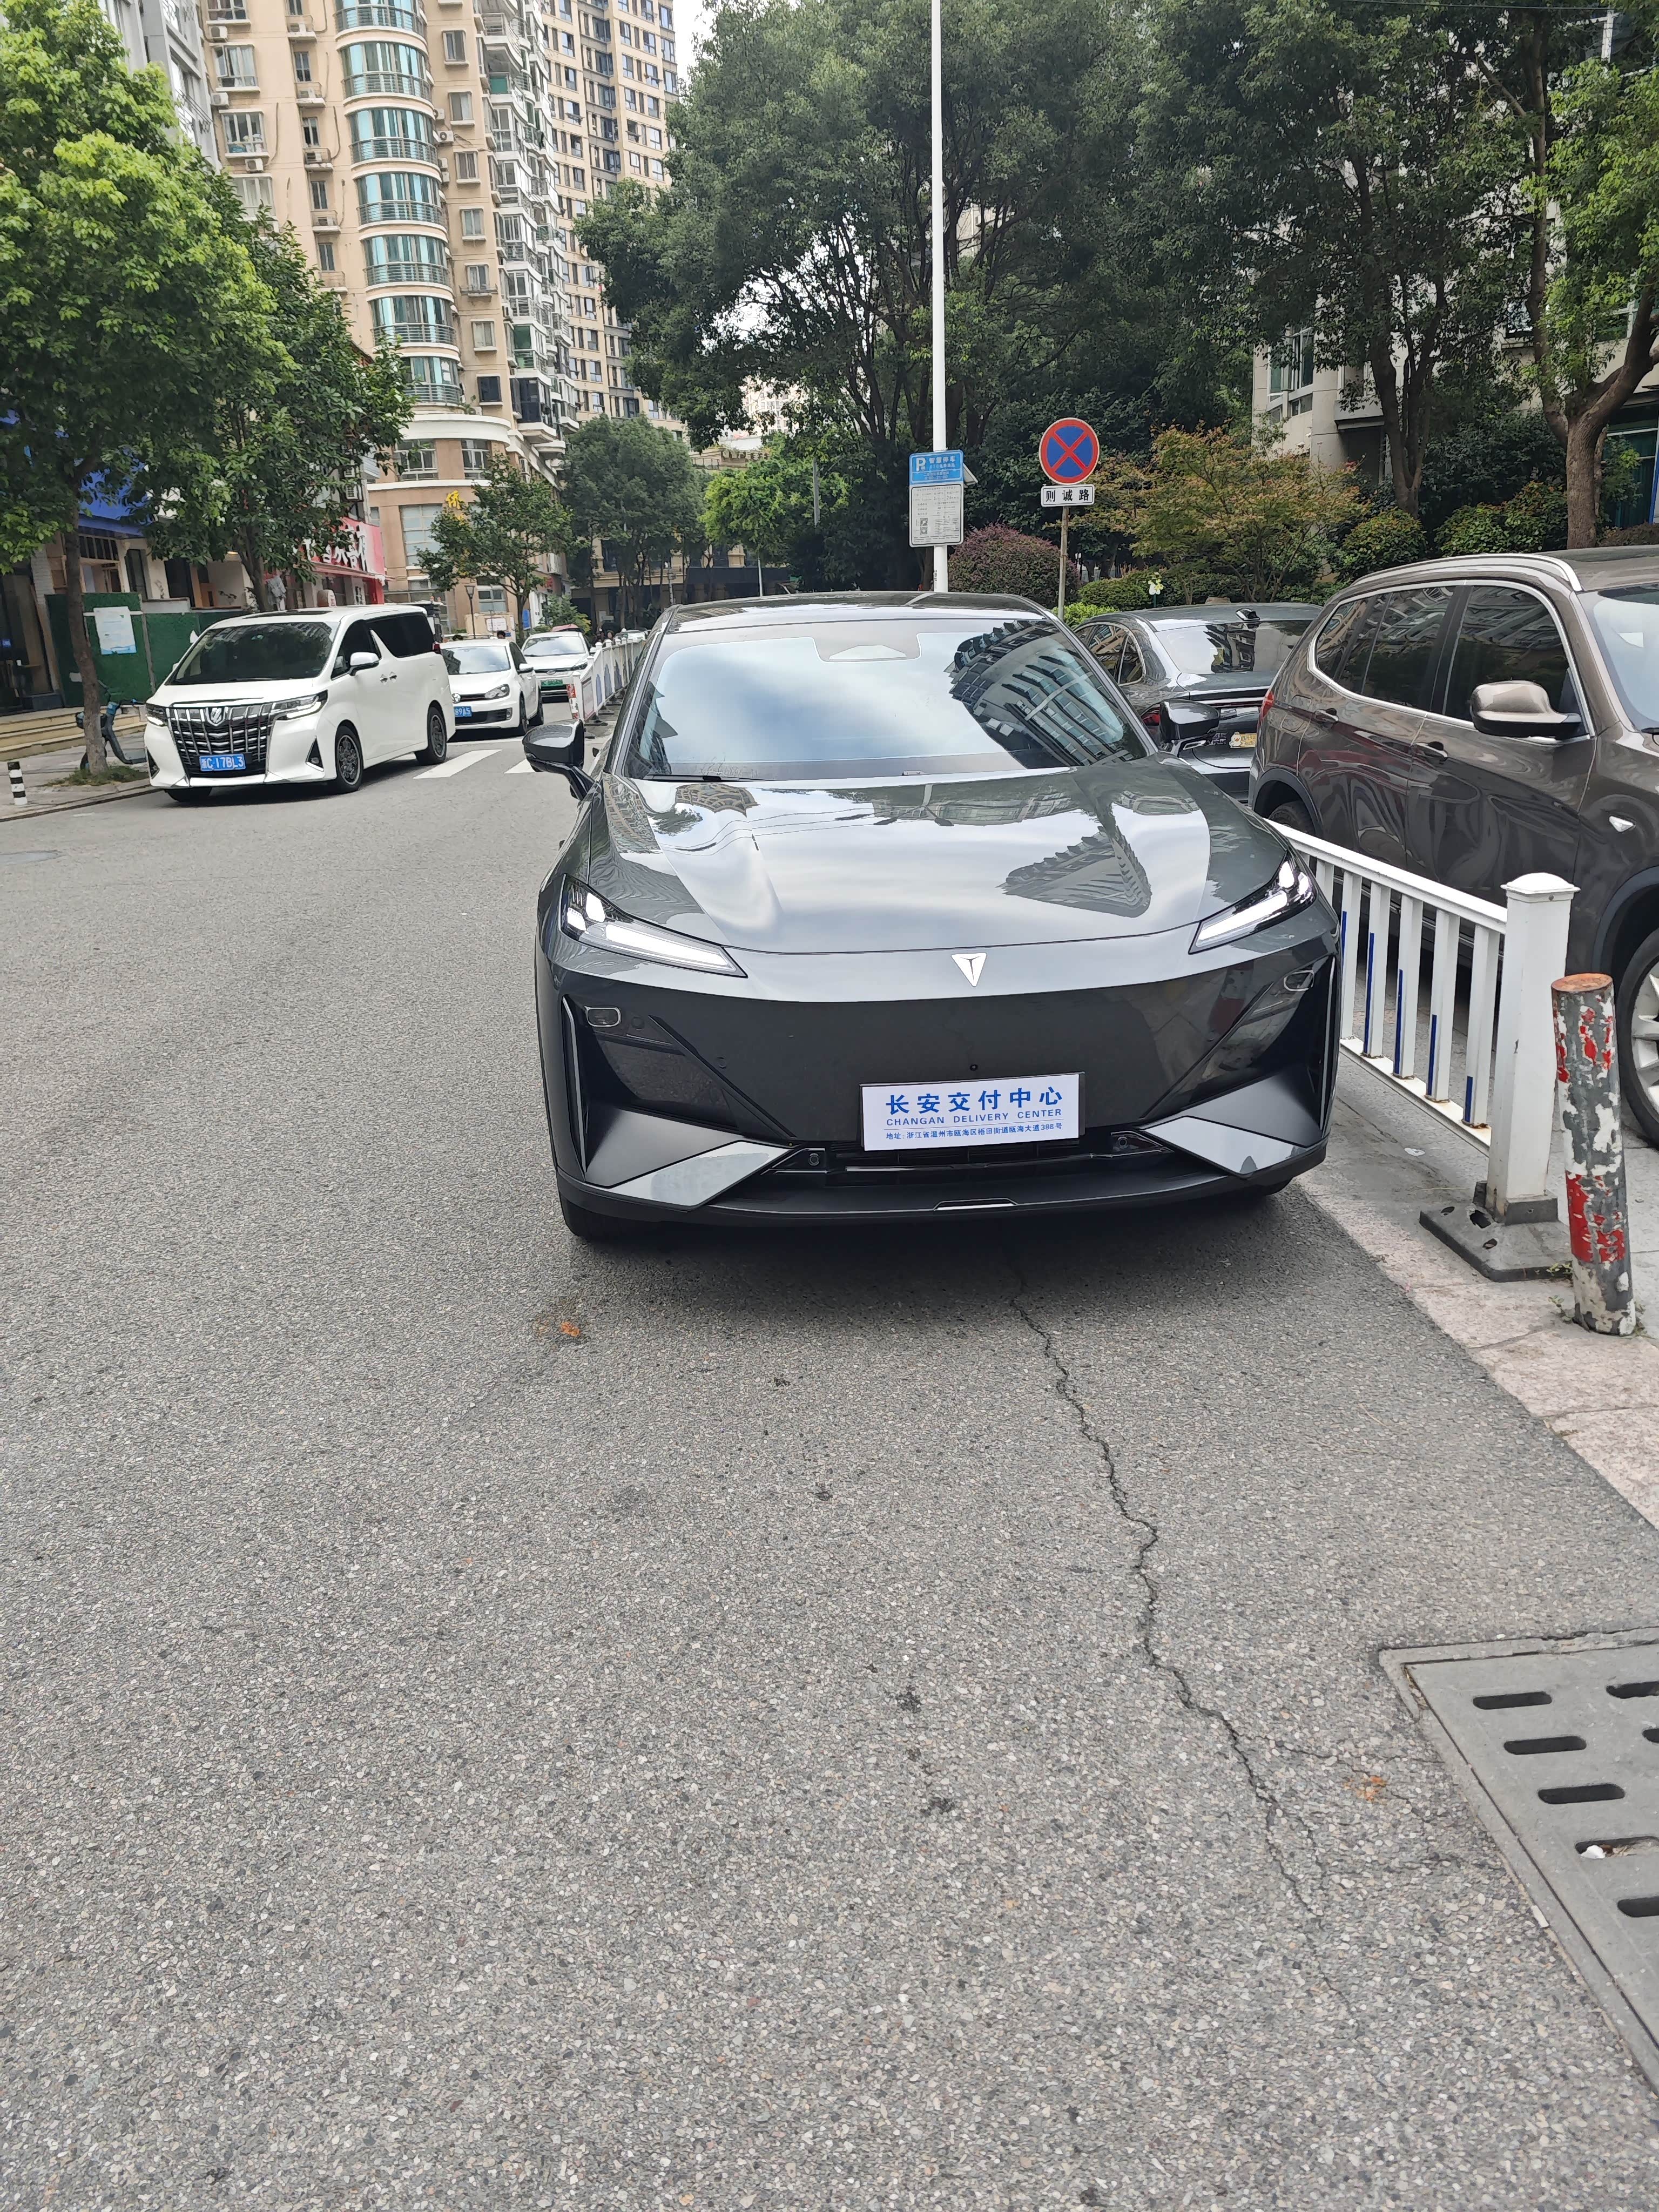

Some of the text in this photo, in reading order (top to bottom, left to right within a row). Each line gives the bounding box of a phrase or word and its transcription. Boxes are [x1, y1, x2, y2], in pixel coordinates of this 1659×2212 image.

[916, 457, 926, 471] P
[1046, 489, 1089, 502] 则诚路
[886, 1087, 1063, 1115] 长安交付中心
[886, 1109, 1062, 1126] CHANGAN DELIVERY CENTER
